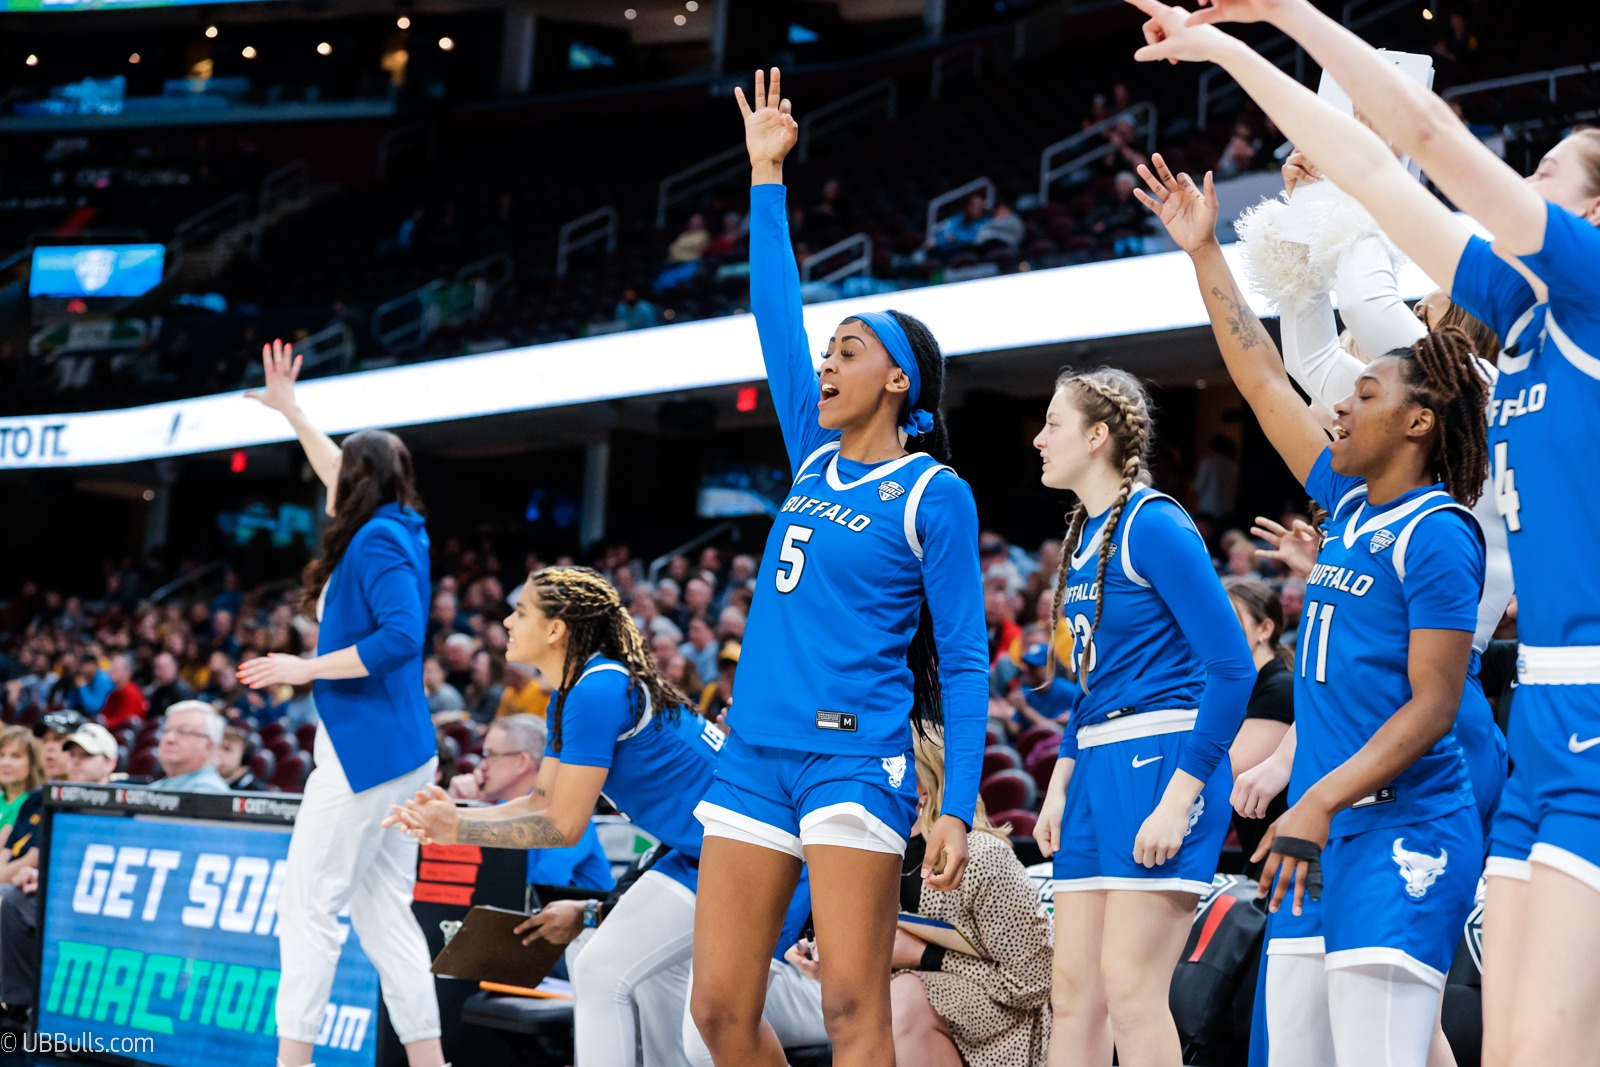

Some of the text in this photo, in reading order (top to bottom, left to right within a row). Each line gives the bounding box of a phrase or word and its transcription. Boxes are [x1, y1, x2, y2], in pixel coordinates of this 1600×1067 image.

[780, 494, 872, 532] BUFFALO
[775, 523, 815, 594] 5
[1301, 600, 1335, 684] 11
[843, 718, 852, 726] M
[1381, 789, 1389, 797] S
[72, 844, 181, 921] GET
